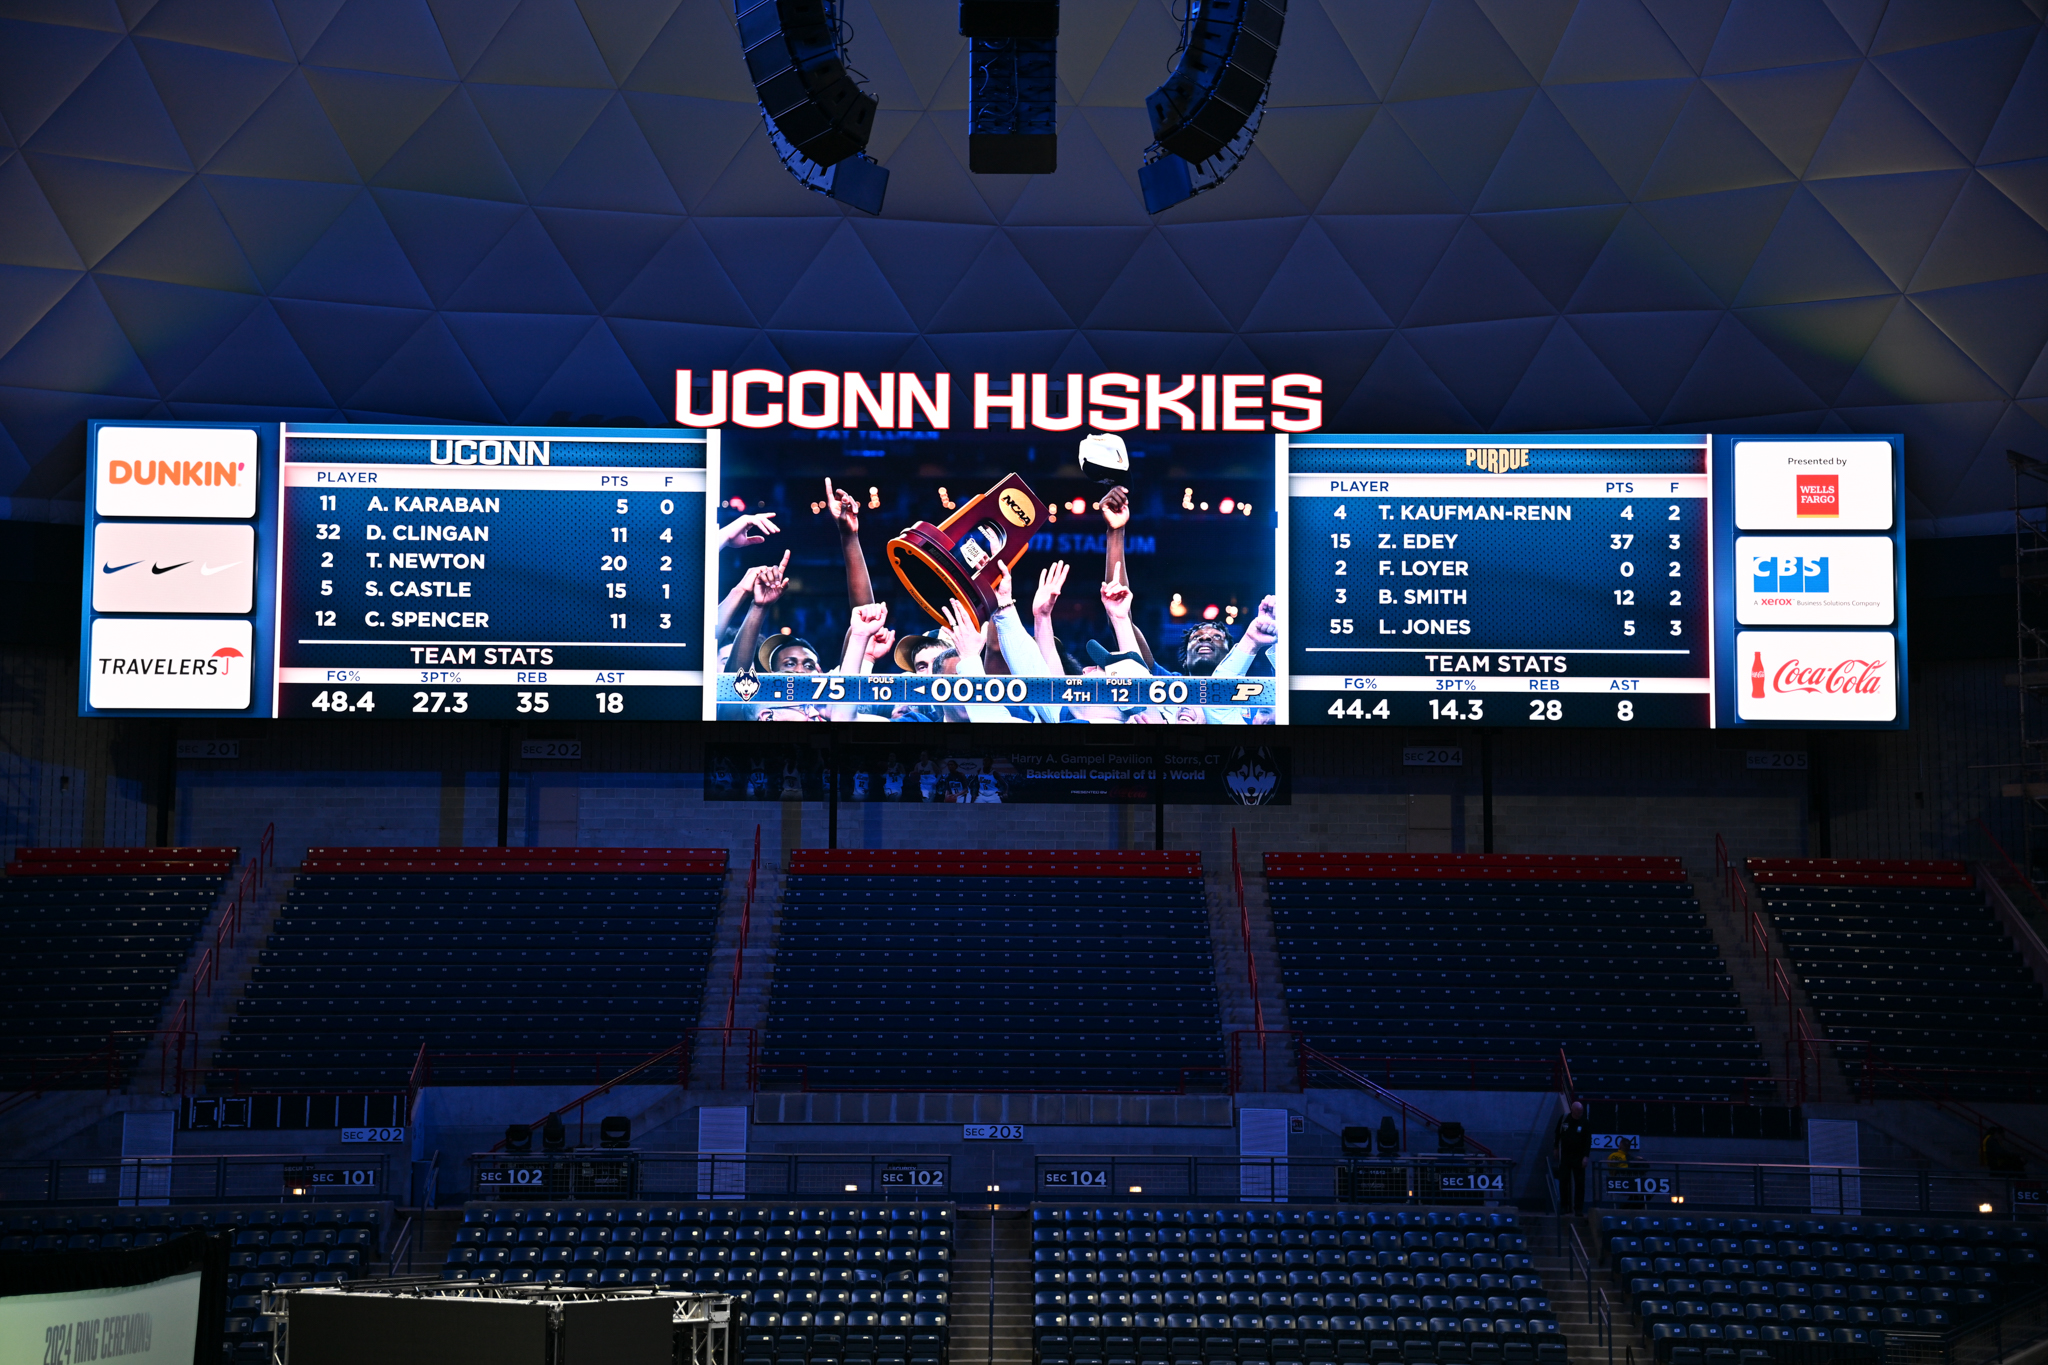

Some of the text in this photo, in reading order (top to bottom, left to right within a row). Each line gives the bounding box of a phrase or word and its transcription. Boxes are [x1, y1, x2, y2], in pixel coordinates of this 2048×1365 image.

[674, 369, 1324, 433] UCONN HUSKIES
[429, 439, 551, 466] UCONN
[1465, 448, 1529, 474] PURDUE
[1788, 457, 1847, 467] Presented by
[109, 459, 245, 487] DUNKIN'
[317, 471, 674, 487] PLAYER PTS F
[1330, 480, 1680, 493] PLAYER PTS F
[1800, 486, 1835, 494] WELLS
[319, 494, 675, 515] 11 A. KARABAN 5 0
[1801, 496, 1835, 504] FARGO
[1001, 495, 1031, 526] NCAA
[1333, 504, 1681, 521] 4 T. KAUFMAN-RENN 4 2
[315, 523, 674, 544] 32 D. CLINGAN 11 4
[1330, 533, 1681, 550] 15 Z. EDEY 37 3
[1057, 532, 1156, 554] STADUM
[320, 551, 673, 572] 2 T. NEWTON 20 2
[1334, 559, 1681, 578] 2 F. LOYER 0 2
[1753, 557, 1822, 577] CBS
[320, 579, 670, 600] 5 S. CASTLE 15 1
[1334, 588, 1682, 606] 3 B. SMITH 12 2
[1761, 598, 1792, 606] xerox
[315, 610, 672, 630] 12 C. SPENCER 11 3
[1329, 618, 1682, 636] 55 L. JONES 5 3
[409, 647, 554, 666] TEAM STATS
[1424, 655, 1567, 673] TEAM STATS
[99, 658, 218, 675] TRAVELERS
[326, 670, 625, 683] FG% 3PT% REB AST
[1344, 677, 1640, 691] FG% 3PT% REB AST
[1773, 659, 1888, 694] Coca-Cola
[811, 677, 845, 700] 75
[872, 686, 892, 700] 10
[931, 679, 1028, 703] 00:00
[1062, 689, 1091, 702] 4TH
[1111, 689, 1129, 702] 12
[1149, 681, 1188, 703] 60
[1231, 683, 1264, 701] P
[311, 690, 624, 714] 48.4 27.3 35 18
[1327, 698, 1634, 722] 44.4 14.3 28 8
[178, 743, 238, 755] SEC 201
[547, 744, 580, 756] 202
[1427, 750, 1461, 763] 204
[1011, 754, 1220, 767] Harry A. Gampel Pavilion Storrs, CT
[1748, 754, 1806, 766] SEC 205
[1026, 769, 1206, 781] Basketball Capital of te World
[368, 1129, 402, 1141] 202
[965, 1126, 1022, 1138] SEC 203
[312, 1170, 374, 1185] SEC 101
[480, 1169, 543, 1184] SEC 102
[882, 1171, 943, 1185] SEC 102
[1046, 1171, 1107, 1185] SEC 104
[1442, 1175, 1504, 1189] SEC 104
[1608, 1178, 1670, 1193] SEC 105
[2017, 1191, 2039, 1200] SEC
[44, 1312, 152, 1365] 2024 RING CEREMONY
